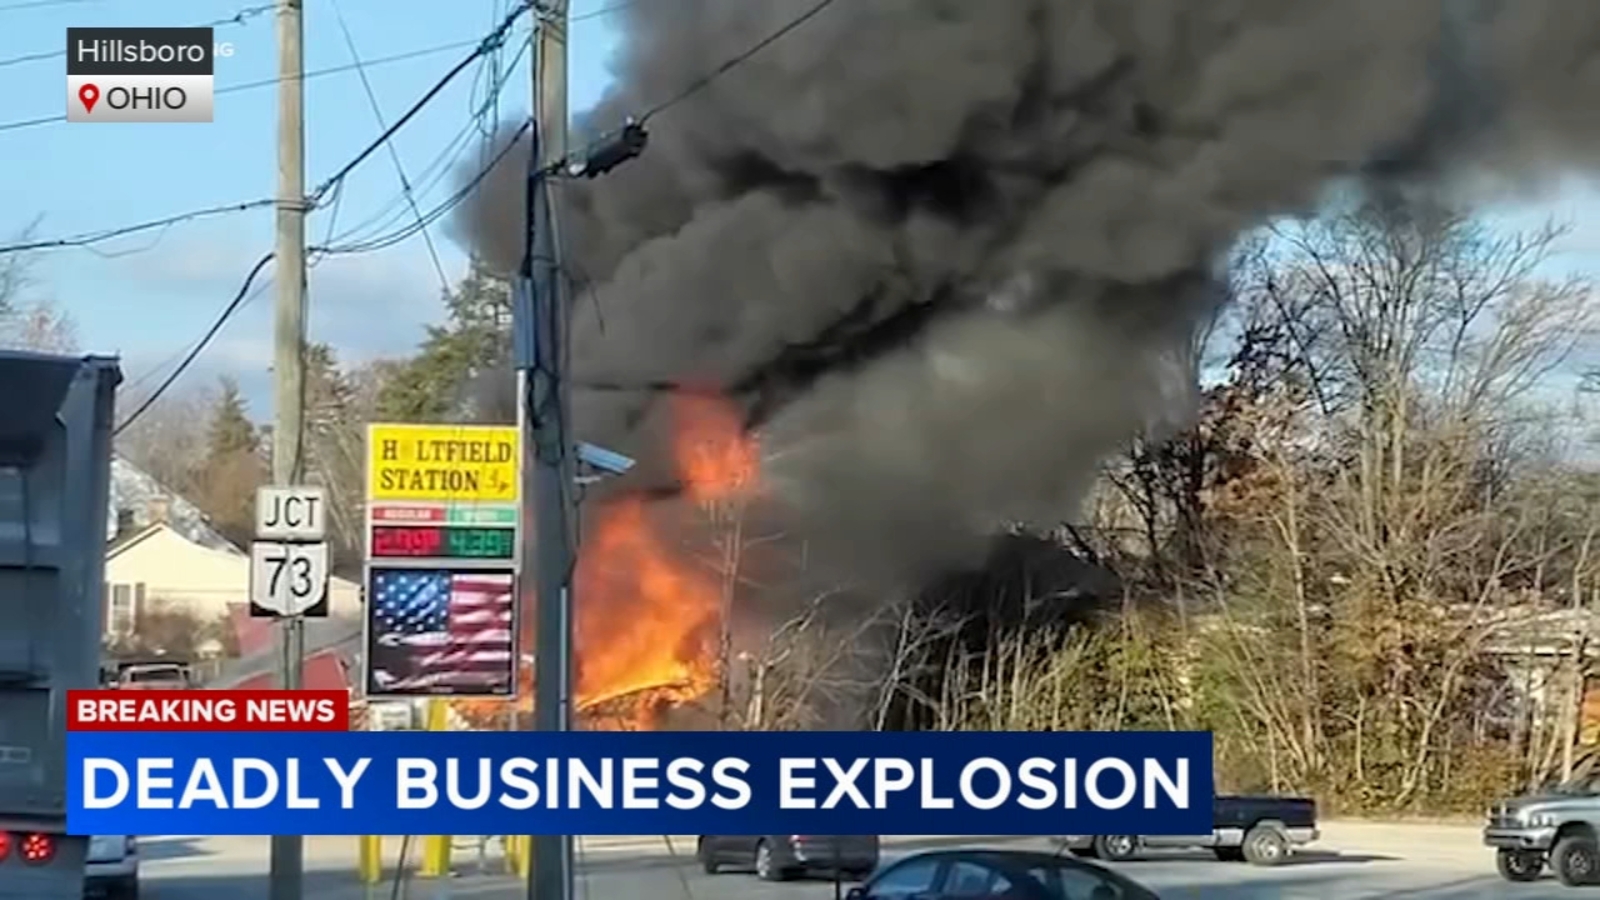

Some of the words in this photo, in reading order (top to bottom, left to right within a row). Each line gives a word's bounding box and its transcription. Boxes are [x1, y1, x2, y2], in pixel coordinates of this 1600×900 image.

[382, 439, 512, 463] HLTFIELD
[380, 467, 480, 491] STATION
[264, 496, 319, 527] JCT
[264, 557, 312, 598] 73
